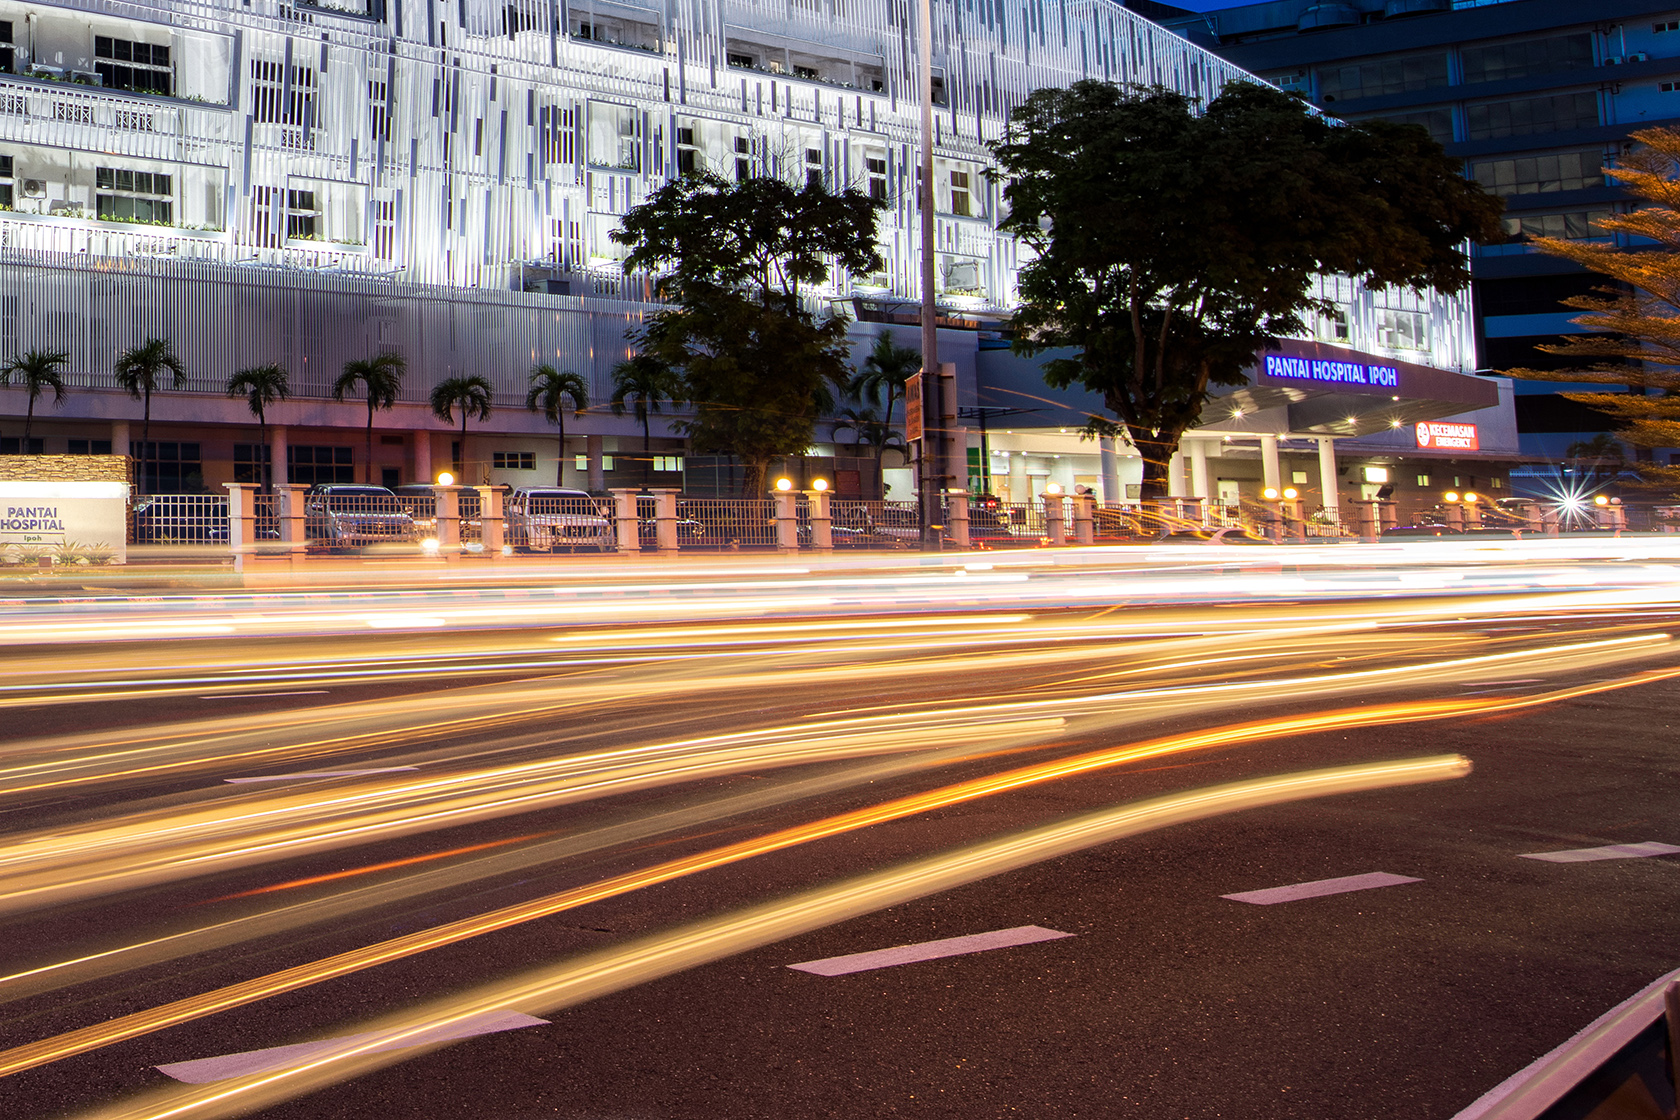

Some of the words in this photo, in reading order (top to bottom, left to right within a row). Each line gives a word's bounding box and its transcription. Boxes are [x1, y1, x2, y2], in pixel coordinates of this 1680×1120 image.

[1266, 355, 1310, 379] PANTAI
[1311, 360, 1367, 384] HOSPITAL
[1368, 365, 1397, 387] IPOH
[1429, 423, 1475, 438] KECEMASAN
[7, 507, 57, 518] PANTAI
[0, 519, 65, 530] HOSPITAL
